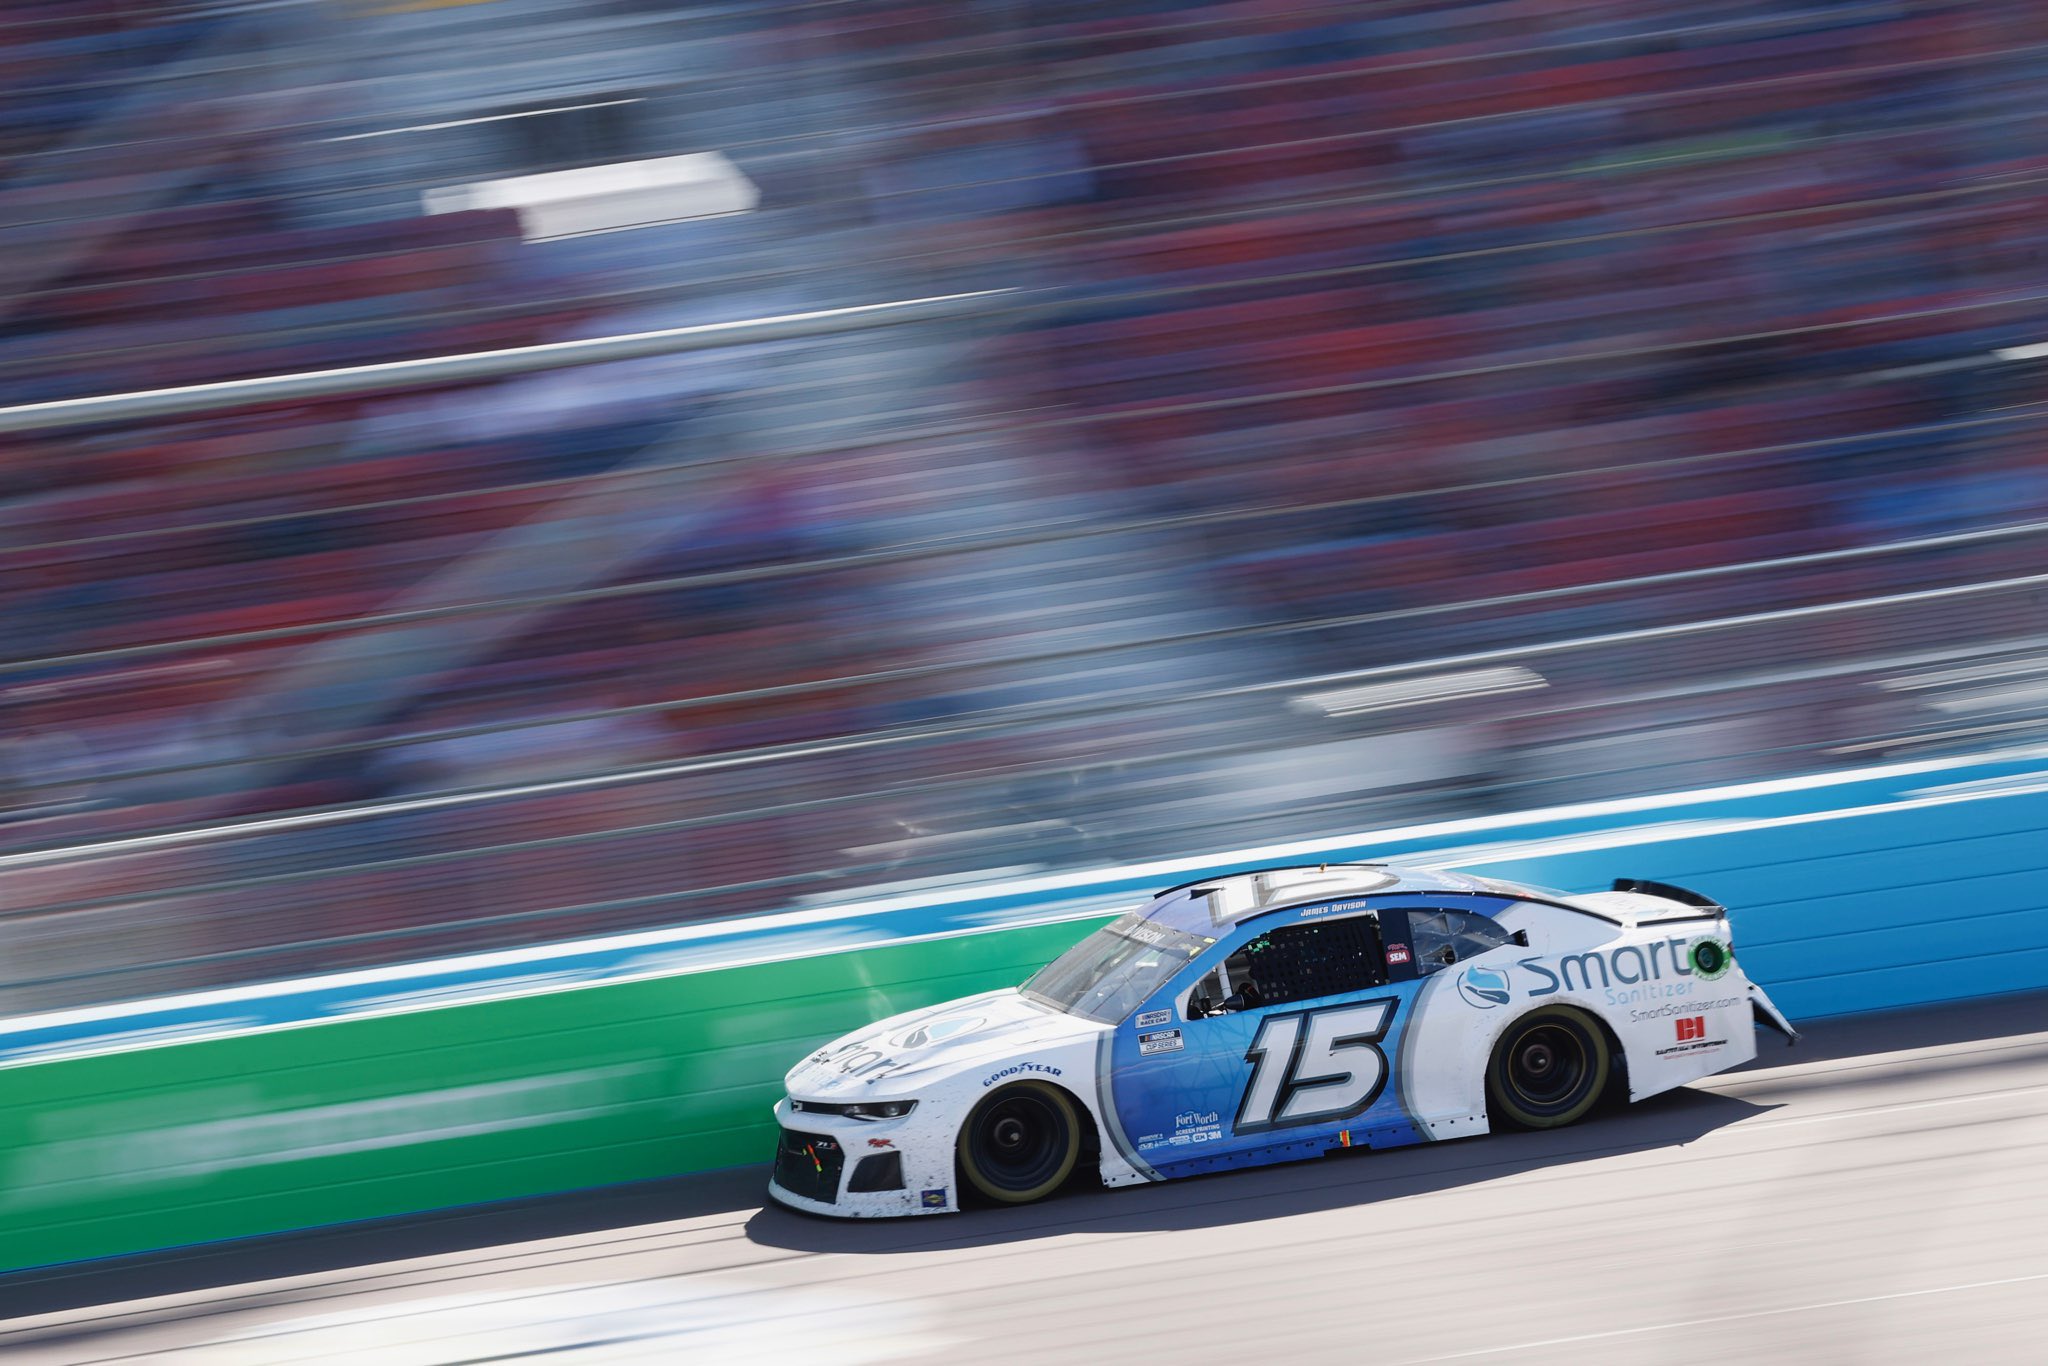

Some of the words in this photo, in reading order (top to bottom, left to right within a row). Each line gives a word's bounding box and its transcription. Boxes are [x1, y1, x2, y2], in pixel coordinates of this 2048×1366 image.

[1301, 906, 1329, 917] JAMES
[1331, 900, 1367, 912] DAVISON
[1389, 951, 1407, 962] SEM
[1604, 981, 1695, 1006] Sanitizer
[1630, 996, 1742, 1023] SmartSanitizer.com
[1151, 1031, 1176, 1041] NASCAR
[1146, 1042, 1158, 1051] CUP
[1158, 1040, 1178, 1048] SERIES
[1234, 998, 1398, 1133] 15
[1176, 1114, 1194, 1128] Fort
[1193, 1111, 1219, 1125] Worth
[1196, 1123, 1220, 1133] PRINTING
[1207, 1130, 1222, 1140] 3M
